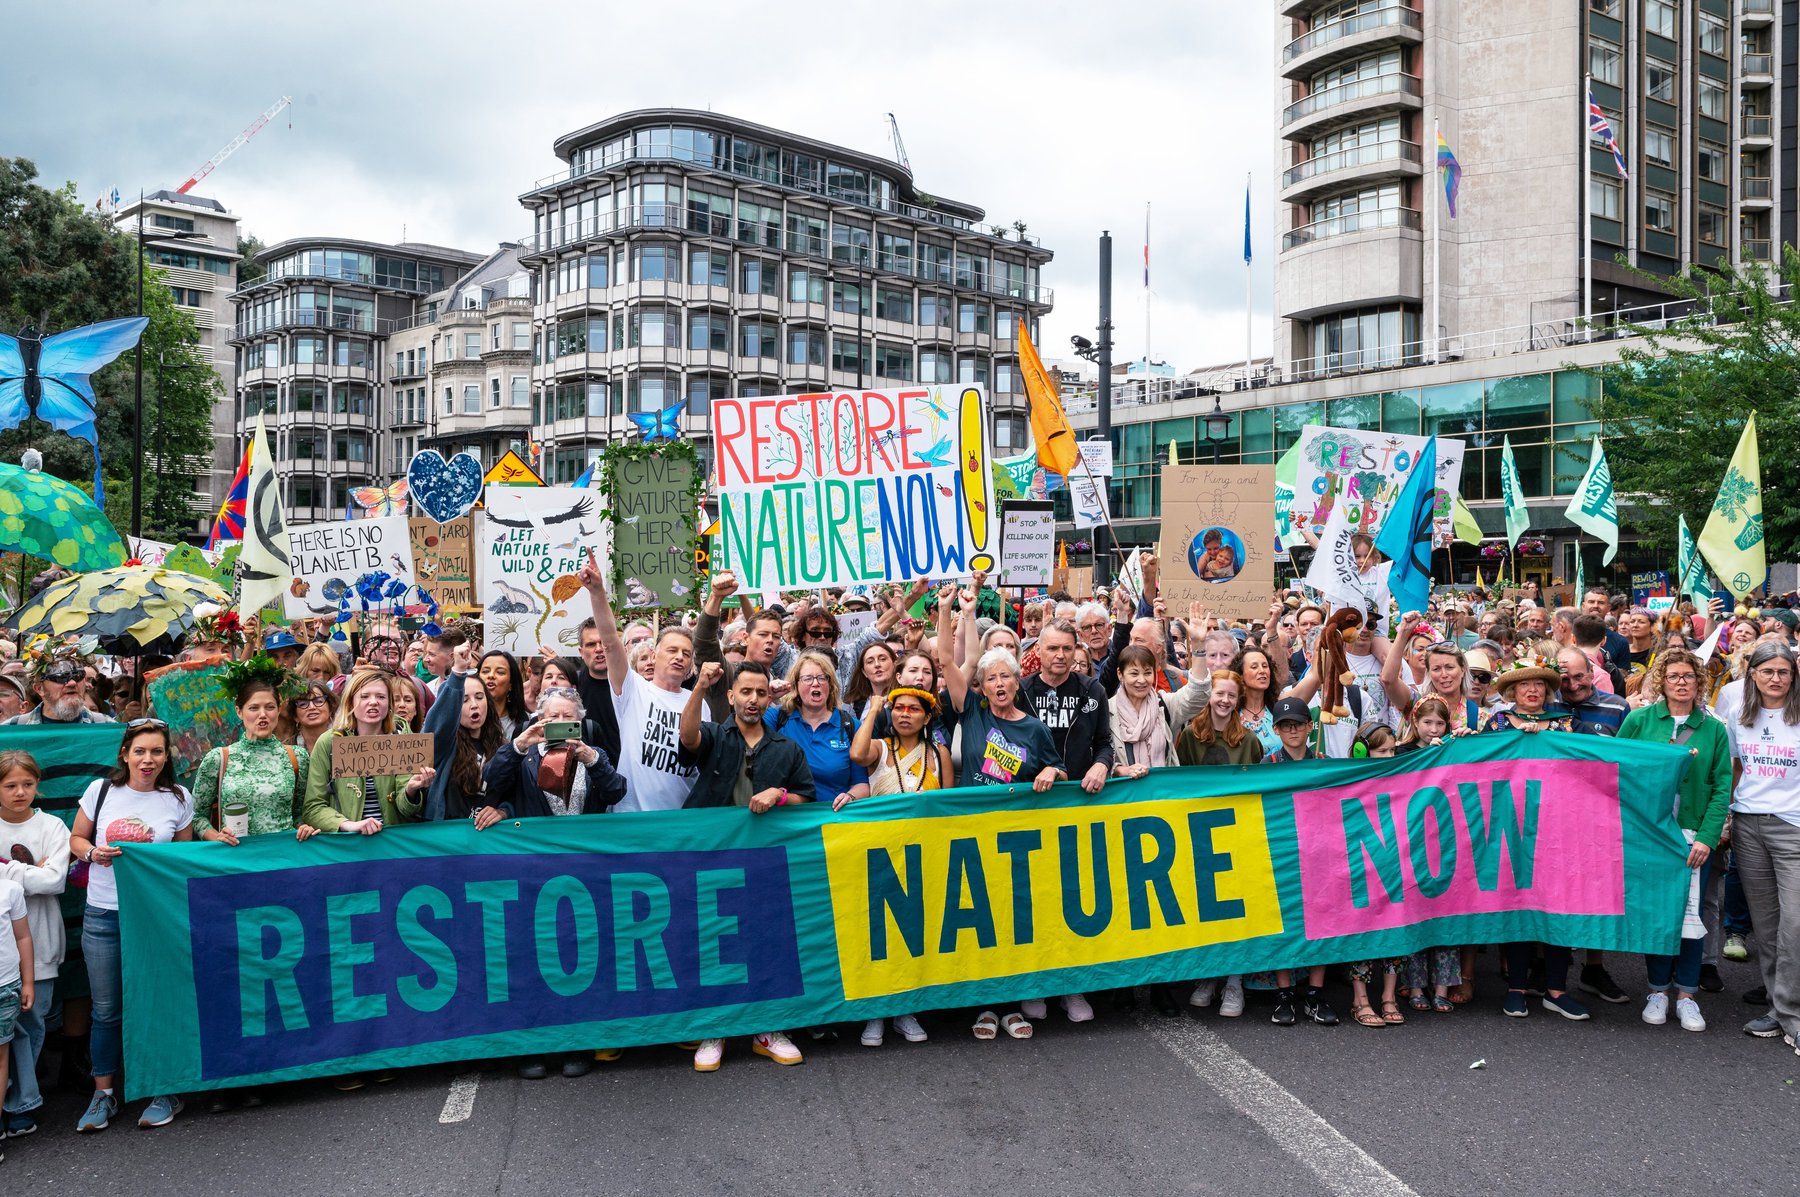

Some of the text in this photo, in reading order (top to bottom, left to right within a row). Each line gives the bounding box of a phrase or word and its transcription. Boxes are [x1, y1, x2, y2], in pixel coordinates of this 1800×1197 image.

[713, 391, 932, 487] RESTORE
[623, 459, 681, 485] GIVE
[1180, 470, 1259, 488] For King and
[617, 490, 690, 515] NATURE
[996, 489, 1013, 498] FOR
[288, 525, 383, 552] THERE IS NO
[510, 528, 534, 542] LET
[637, 520, 675, 545] HER
[721, 479, 884, 589] NATURE
[1172, 523, 1195, 564] Planet
[290, 546, 384, 576] PLANET B.
[491, 543, 550, 556] NATURE
[502, 557, 589, 583] WILD & FRE
[621, 551, 692, 576] RIGHTS
[1167, 588, 1266, 602] be the Restoration
[1176, 602, 1241, 615] Geration
[850, 618, 860, 627] NO
[648, 701, 654, 718] I
[644, 720, 675, 747] SAVE
[989, 731, 1023, 759] RESTORE
[339, 738, 429, 755] SAVE OUR ANCIENT
[1741, 743, 1796, 758] THE TIME
[341, 752, 426, 774] WOODLAND
[988, 746, 1018, 772] NATURE
[1752, 755, 1798, 768] WETLANDS
[974, 773, 983, 782] 22
[1745, 764, 1787, 778] S NOW
[235, 779, 1542, 1038] RESTORE NATURE NOW
